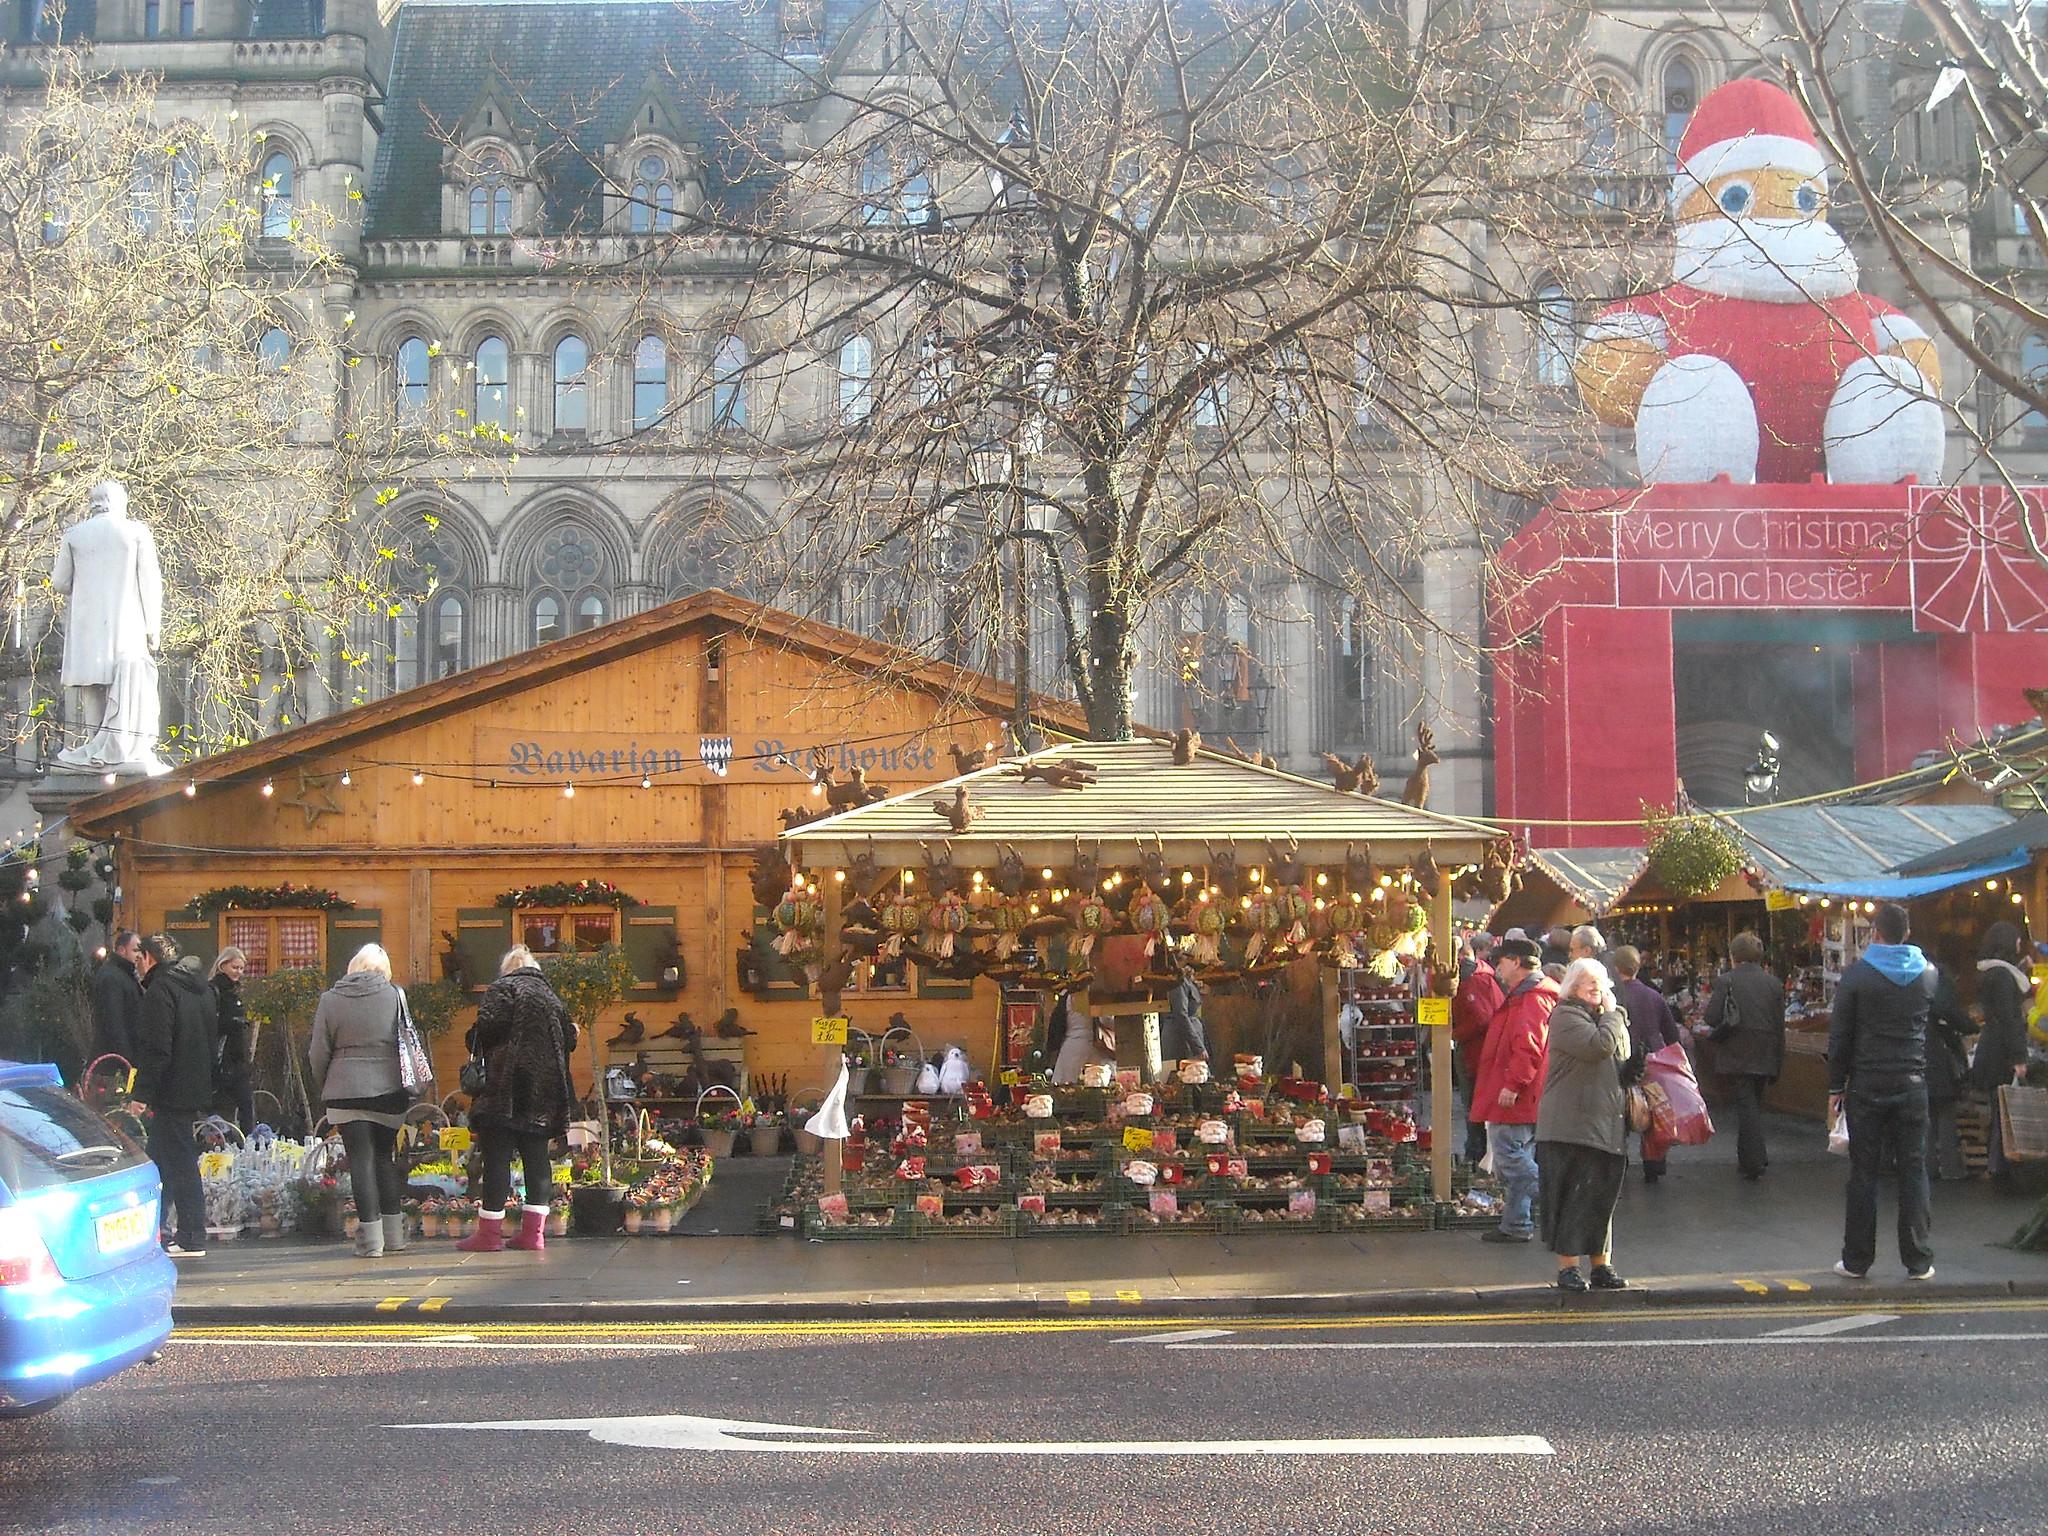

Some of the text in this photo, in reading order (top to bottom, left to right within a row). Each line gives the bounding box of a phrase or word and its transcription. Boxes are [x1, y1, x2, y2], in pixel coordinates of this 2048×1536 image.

[1618, 510, 1907, 559] Merry Christmas
[1658, 562, 1872, 601] Manchester
[508, 741, 682, 776] Bavarian
